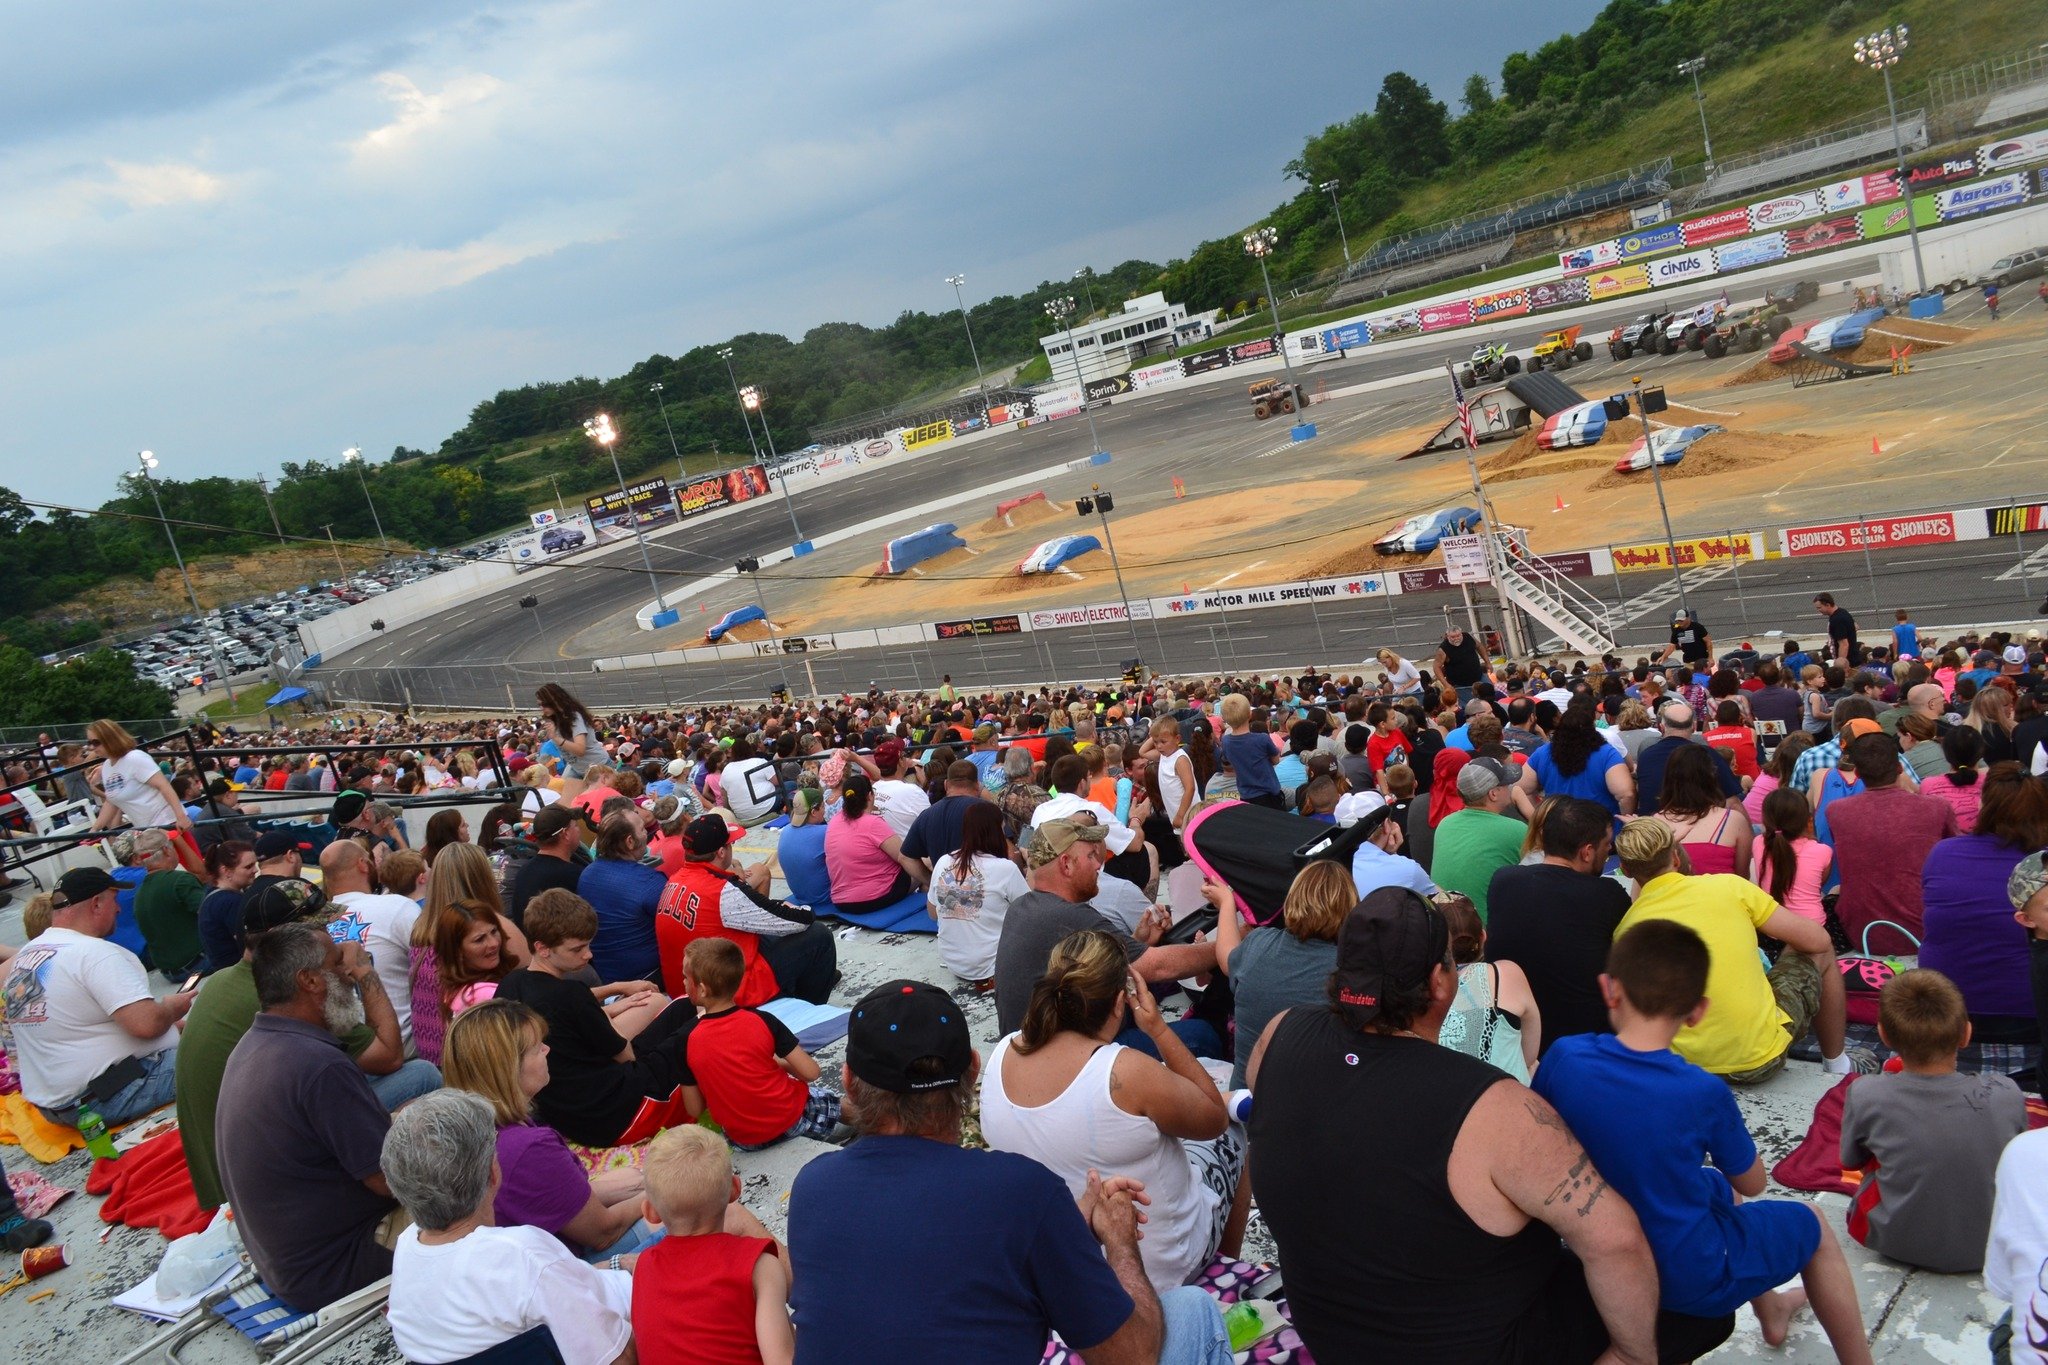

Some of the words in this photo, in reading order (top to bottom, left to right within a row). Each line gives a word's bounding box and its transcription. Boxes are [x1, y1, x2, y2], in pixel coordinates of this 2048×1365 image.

[1951, 181, 2014, 205] Aaron's
[1757, 198, 1801, 219] SHIVELY
[1830, 200, 1861, 211] Domino's
[1685, 209, 1747, 231] audiotronics
[1766, 211, 1797, 222] ELECTRIC
[1641, 230, 1676, 245] ETHOS
[1477, 303, 1494, 316] Mix
[1493, 294, 1524, 312] 102.9
[1089, 383, 1117, 399] Sprint
[906, 422, 948, 446] JEGS
[769, 461, 812, 481] COMETIC
[628, 487, 640, 496] WE
[639, 481, 657, 492] RACE
[606, 499, 623, 510] WHY
[634, 490, 654, 501] RACE.
[1443, 537, 1479, 547] WELCOME
[1791, 529, 1846, 551] SHONEY'S
[1850, 526, 1869, 537] EXT
[1871, 525, 1885, 535] 98
[1891, 518, 1951, 541] SHONEY'S
[1851, 534, 1886, 545] DUBLIN
[1204, 595, 1243, 608] MOTOR
[1248, 591, 1276, 603] MILE
[1280, 584, 1337, 600] SPEEDWAY
[1055, 610, 1088, 625] SHIVELY
[1089, 605, 1128, 620] ELECTRIC
[656, 882, 701, 931] ULLS
[1340, 990, 1376, 1007] Intimidator
[24, 1001, 48, 1018] 14
